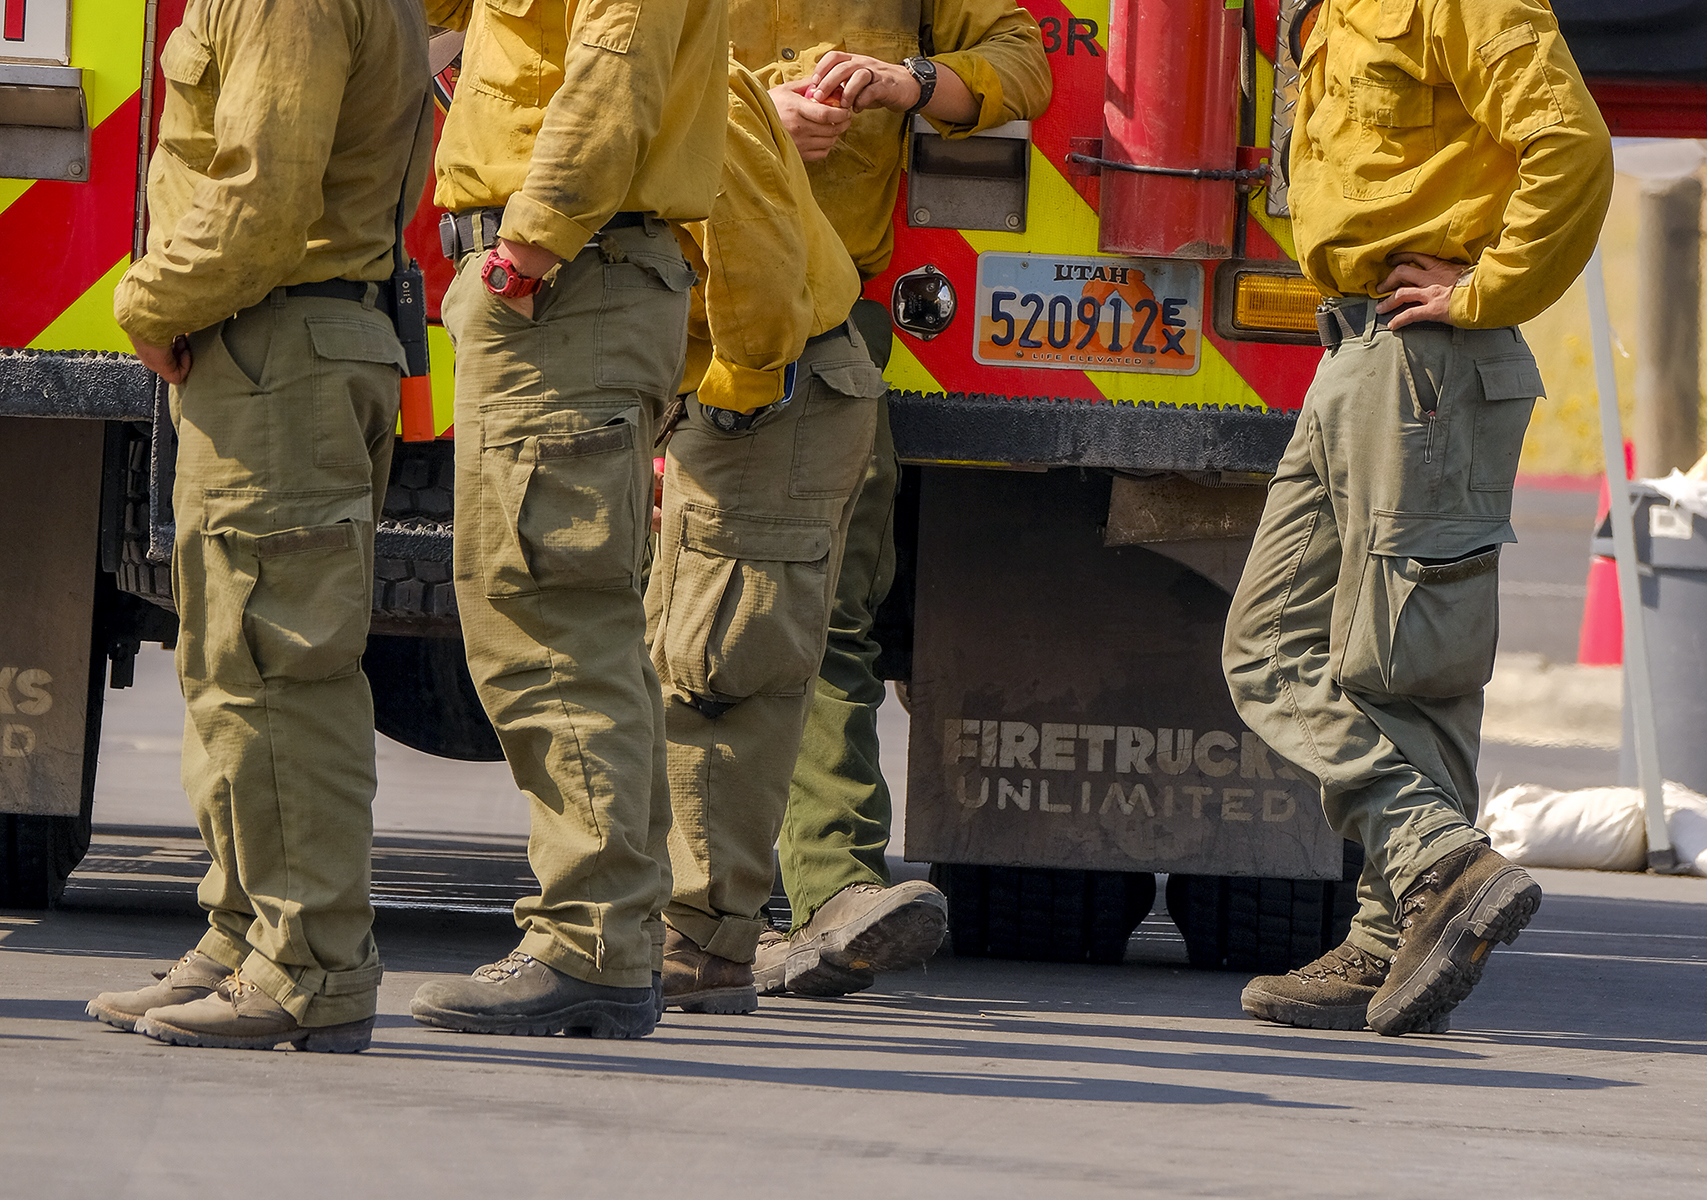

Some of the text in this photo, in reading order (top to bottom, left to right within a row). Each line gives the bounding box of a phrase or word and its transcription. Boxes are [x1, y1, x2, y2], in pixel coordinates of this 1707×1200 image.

[1053, 264, 1131, 285] UTAH
[991, 291, 1158, 354] 520912
[1032, 353, 1142, 365] LIFE ELEVATED
[957, 776, 1297, 822] UNLIMITED
